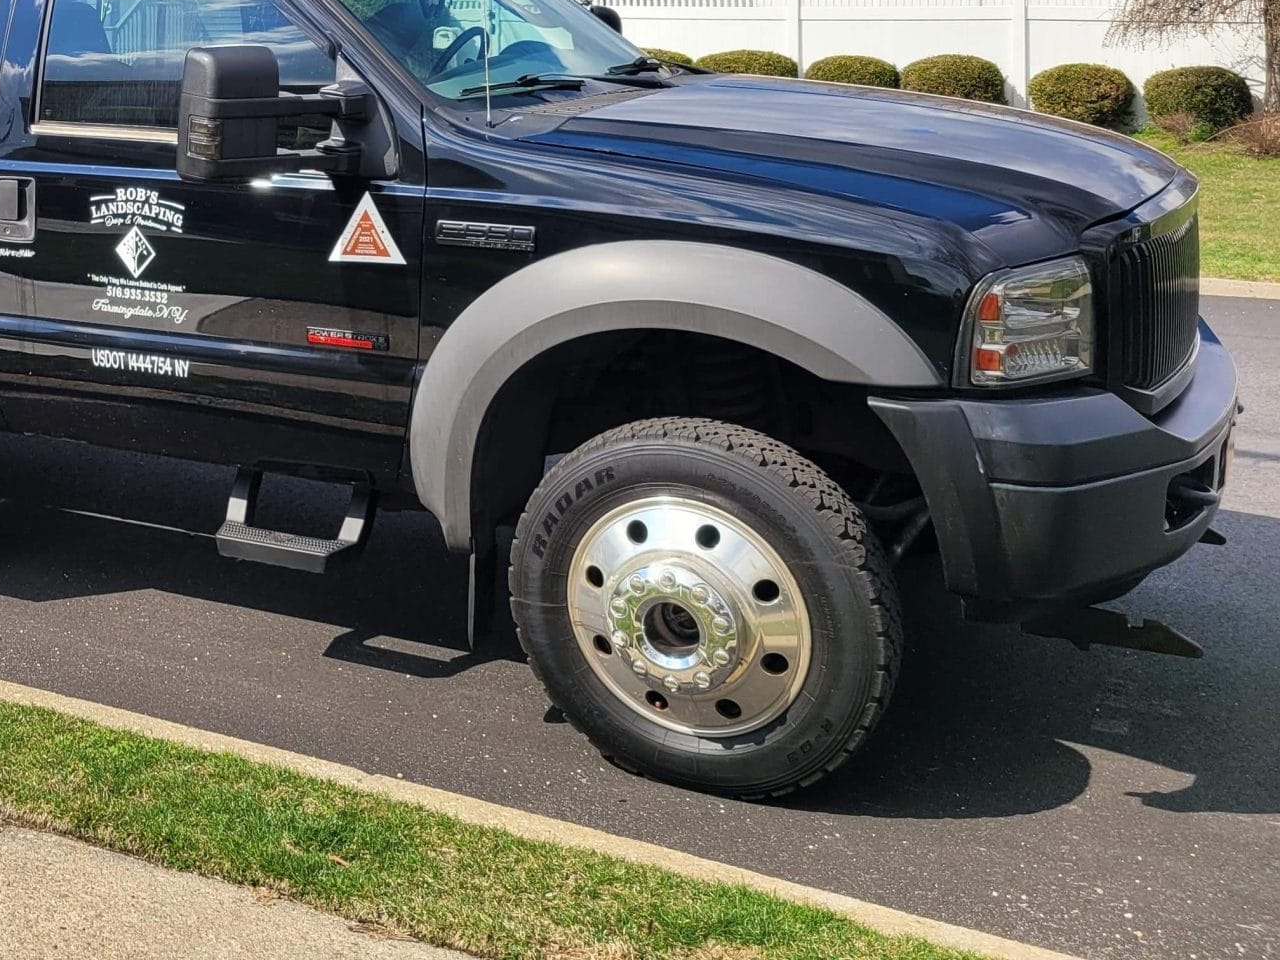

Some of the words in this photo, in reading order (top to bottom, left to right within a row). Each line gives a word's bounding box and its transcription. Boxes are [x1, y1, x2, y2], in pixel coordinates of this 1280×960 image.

[116, 188, 159, 205] ROB'S
[90, 202, 183, 227] LANDSCAPING
[125, 215, 131, 224] &
[92, 348, 125, 370] USDOT
[175, 359, 190, 378] NY
[531, 466, 615, 559] RADAR
